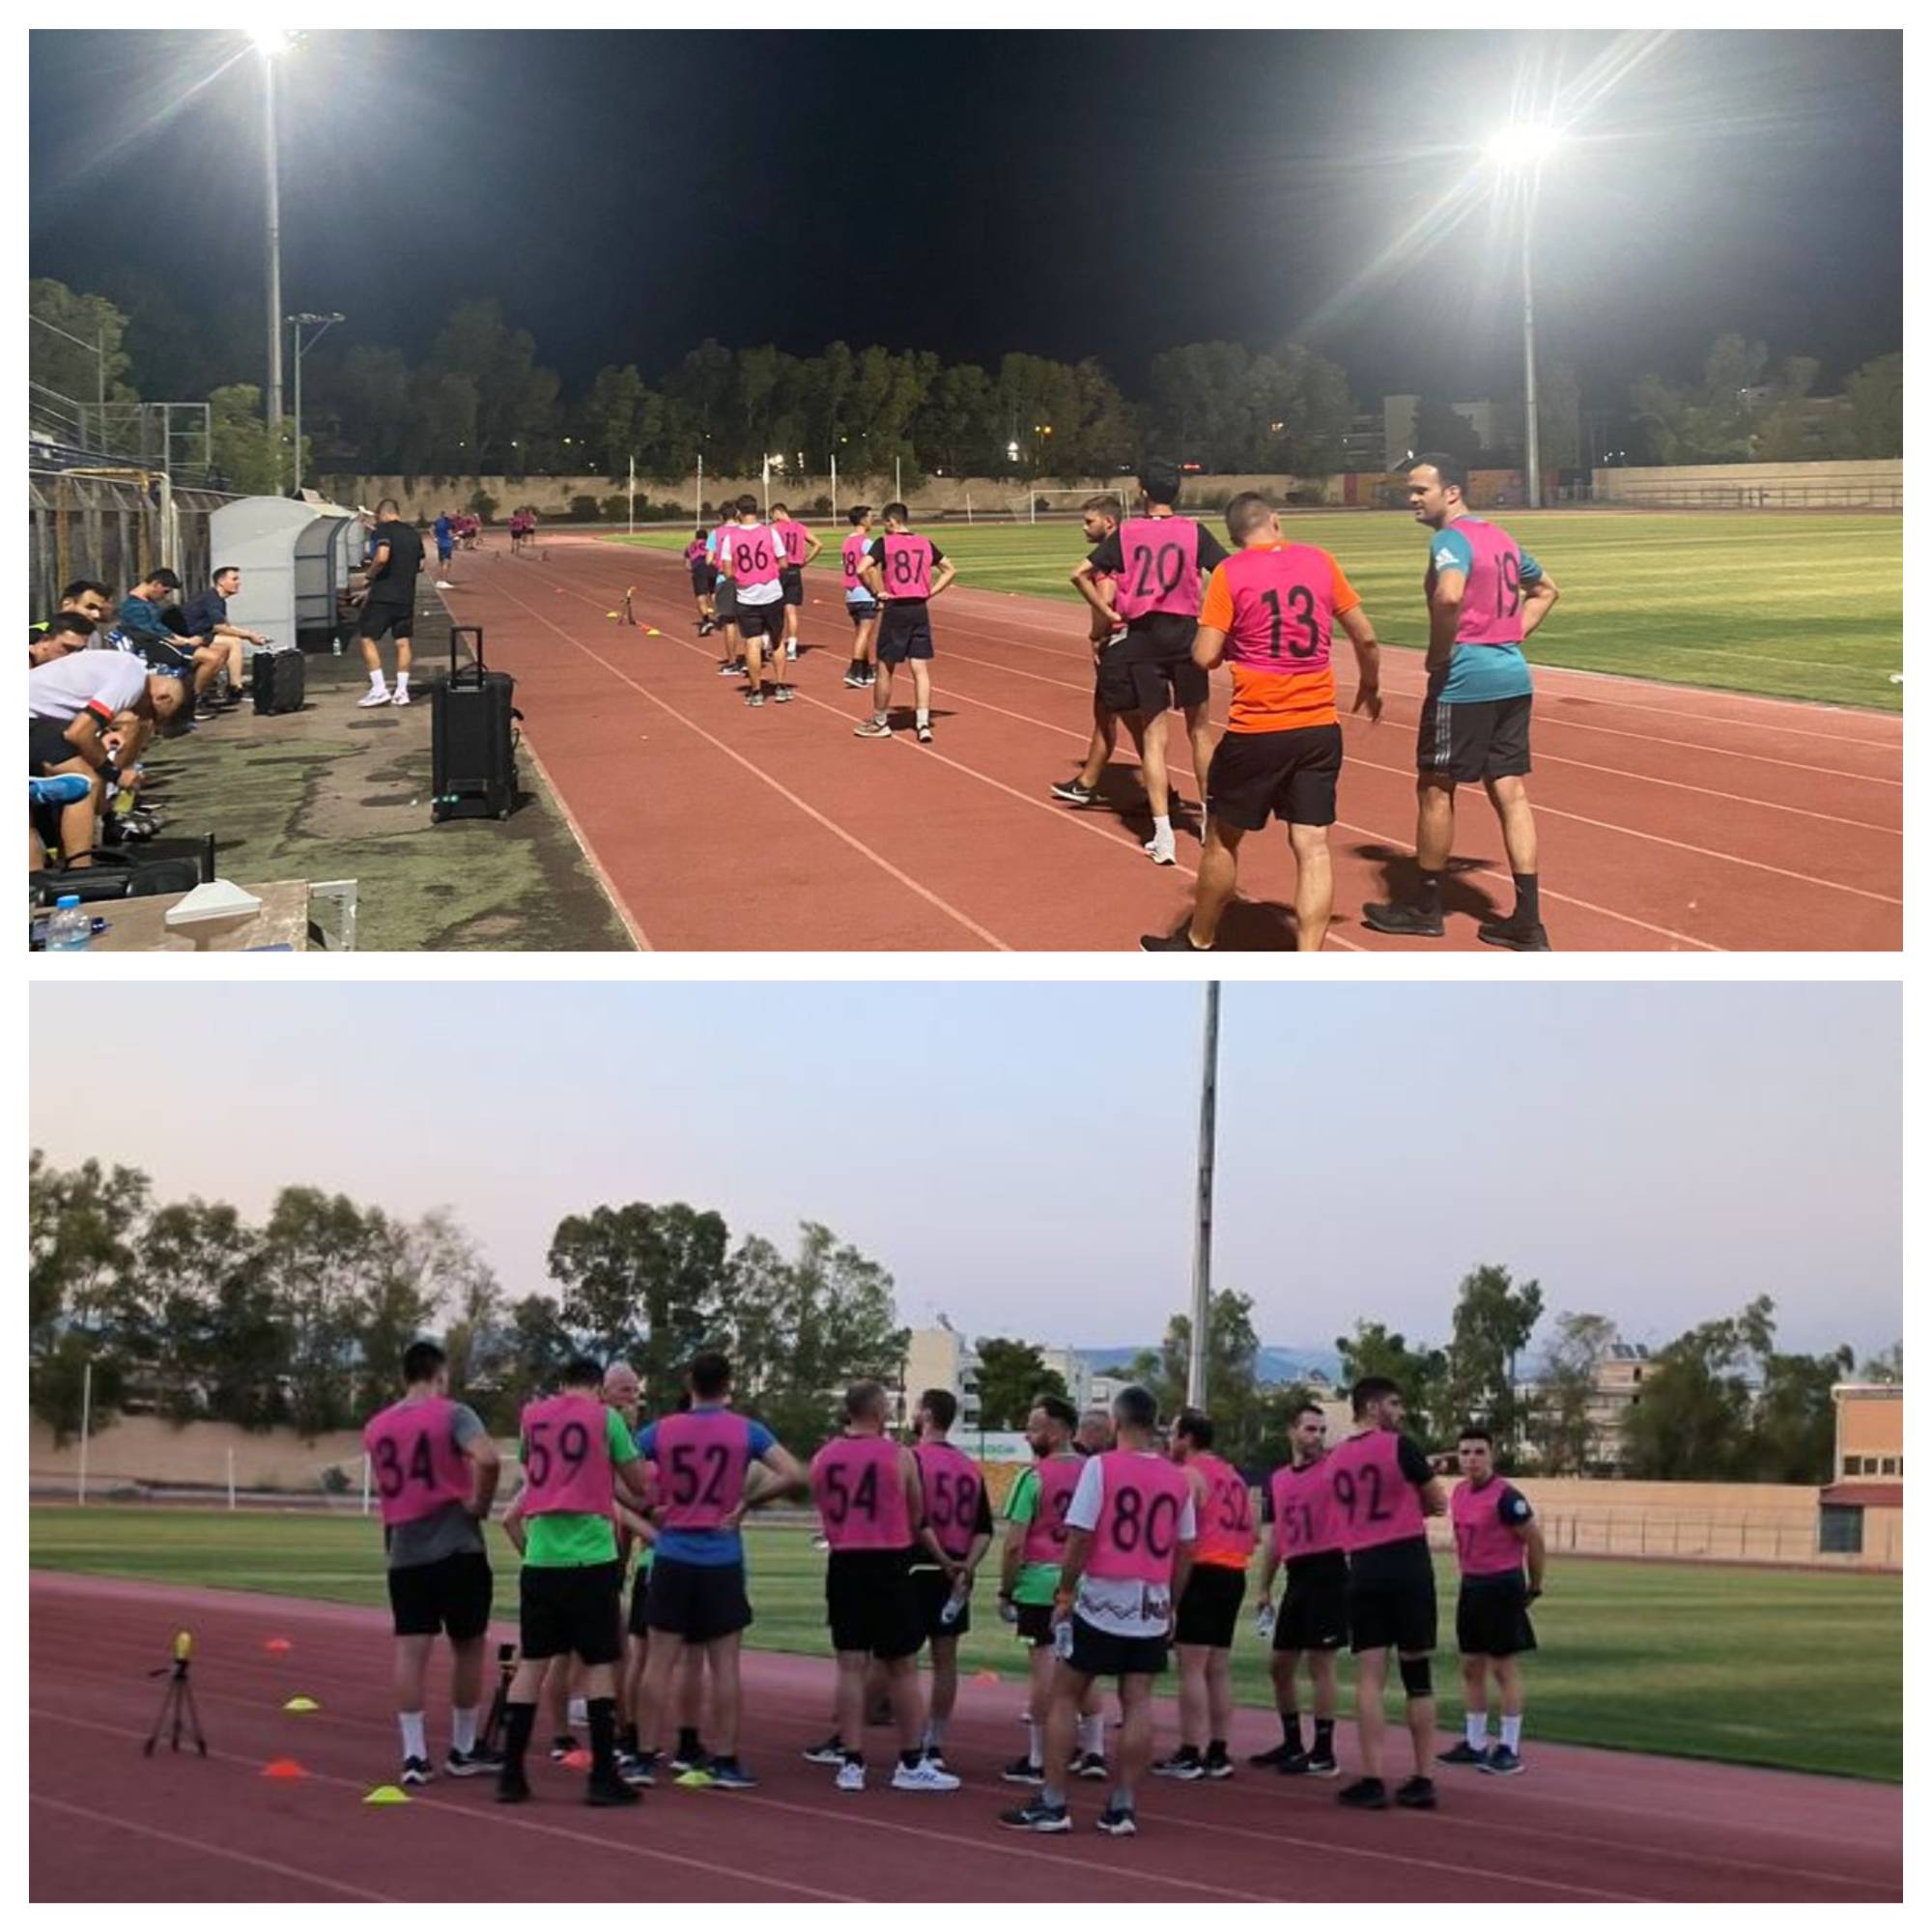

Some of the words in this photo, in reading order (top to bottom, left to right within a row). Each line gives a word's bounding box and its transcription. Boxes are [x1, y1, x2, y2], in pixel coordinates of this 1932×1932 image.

[736, 540, 769, 574] 86
[895, 548, 925, 583] 87
[1494, 552, 1519, 619] 19
[1261, 583, 1321, 660] 13
[375, 1430, 437, 1499] 34
[526, 1422, 589, 1488] 59
[671, 1444, 730, 1507] 52
[825, 1461, 878, 1524] 54
[932, 1474, 978, 1527] 58
[1111, 1486, 1179, 1559] 80
[1215, 1477, 1253, 1531] 32
[1284, 1503, 1314, 1545] 51
[1333, 1463, 1394, 1524] 92
